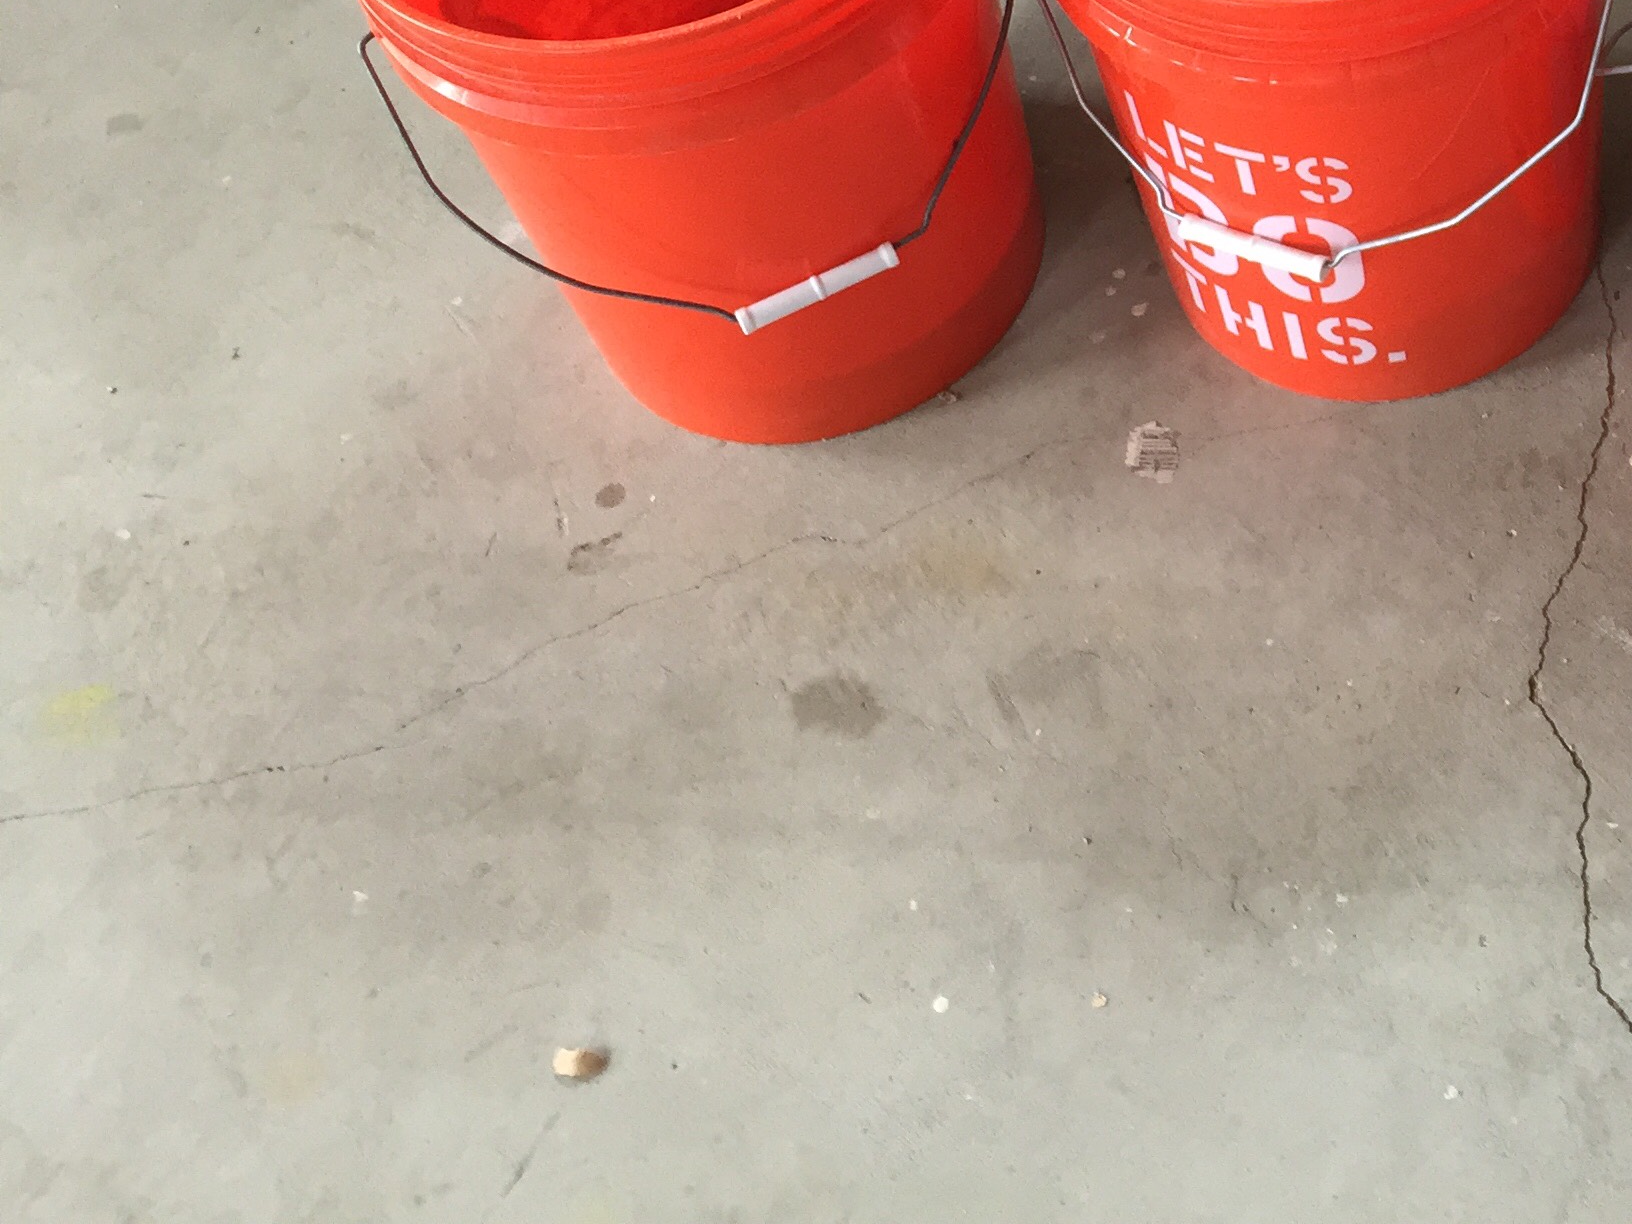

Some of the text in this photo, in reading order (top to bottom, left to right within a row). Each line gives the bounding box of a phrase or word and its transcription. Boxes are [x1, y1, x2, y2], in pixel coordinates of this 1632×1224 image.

[1124, 90, 1353, 204] LET'S
[1144, 151, 1366, 304] DO
[1170, 247, 1407, 366] THIS.
